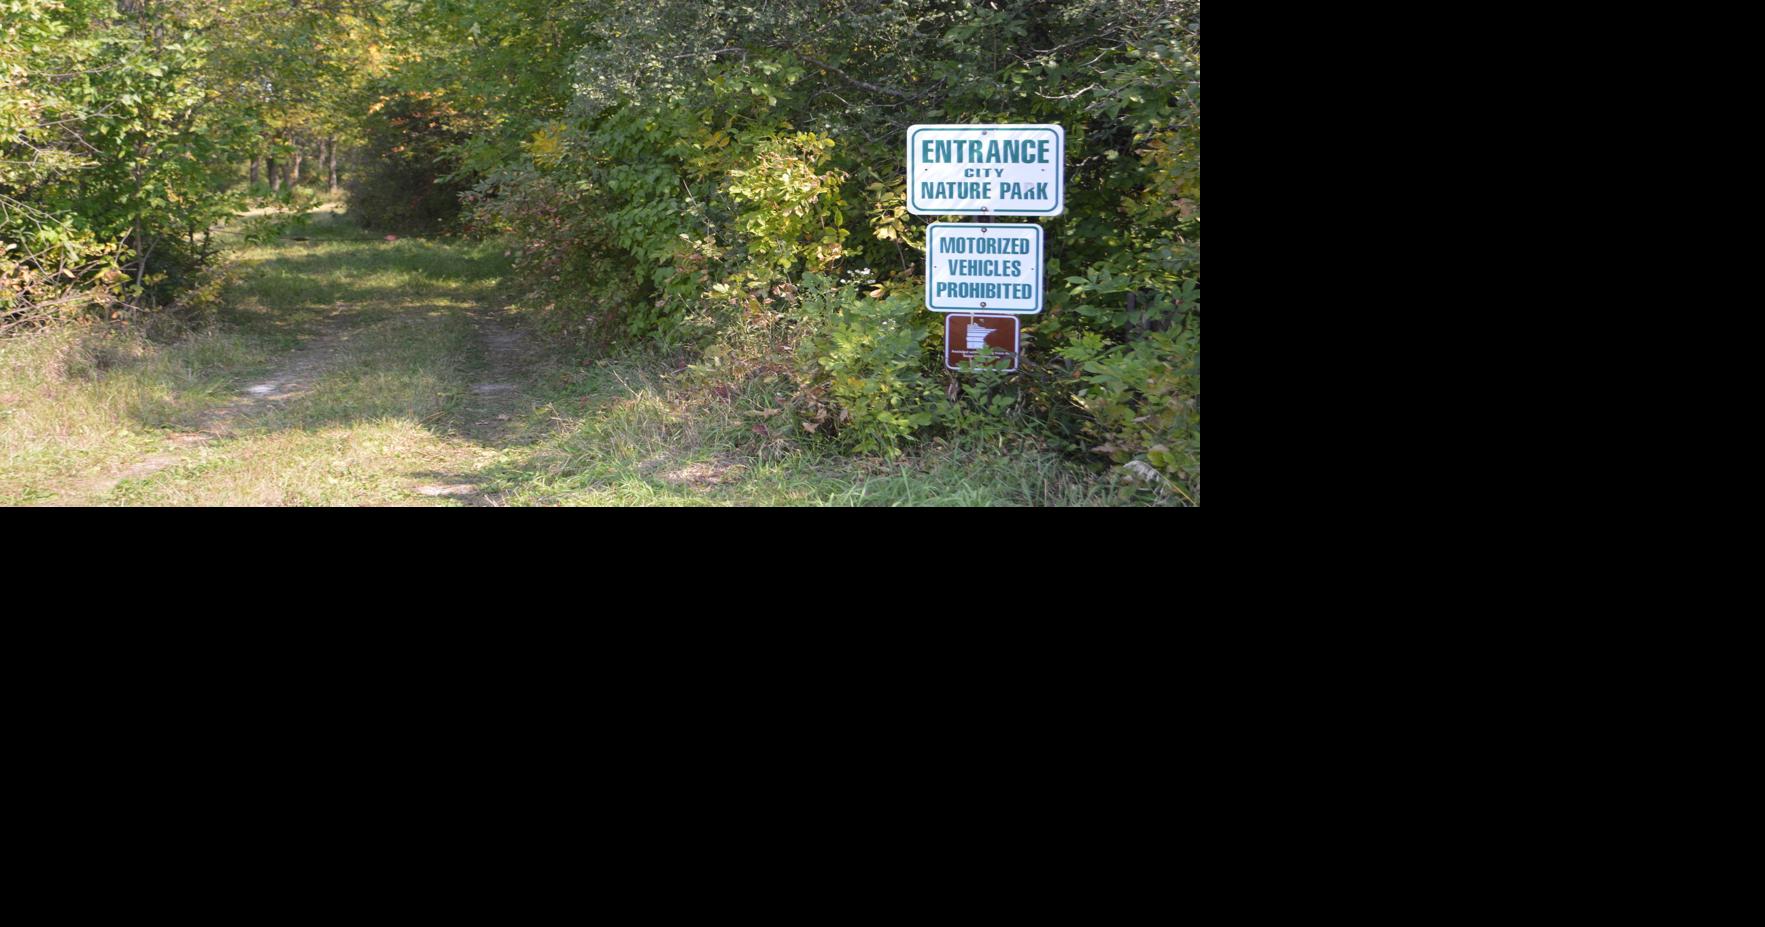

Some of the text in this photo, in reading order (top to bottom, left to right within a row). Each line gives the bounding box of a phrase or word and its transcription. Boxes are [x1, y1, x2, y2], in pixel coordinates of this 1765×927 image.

[921, 139, 1050, 164] ENTRANCE
[964, 168, 1004, 178] CITY
[921, 181, 1049, 200] NATURE PARK
[939, 236, 1030, 255] MOTORIZED
[947, 259, 1021, 277] VEHICLES
[936, 281, 1033, 300] PROHIBITED
